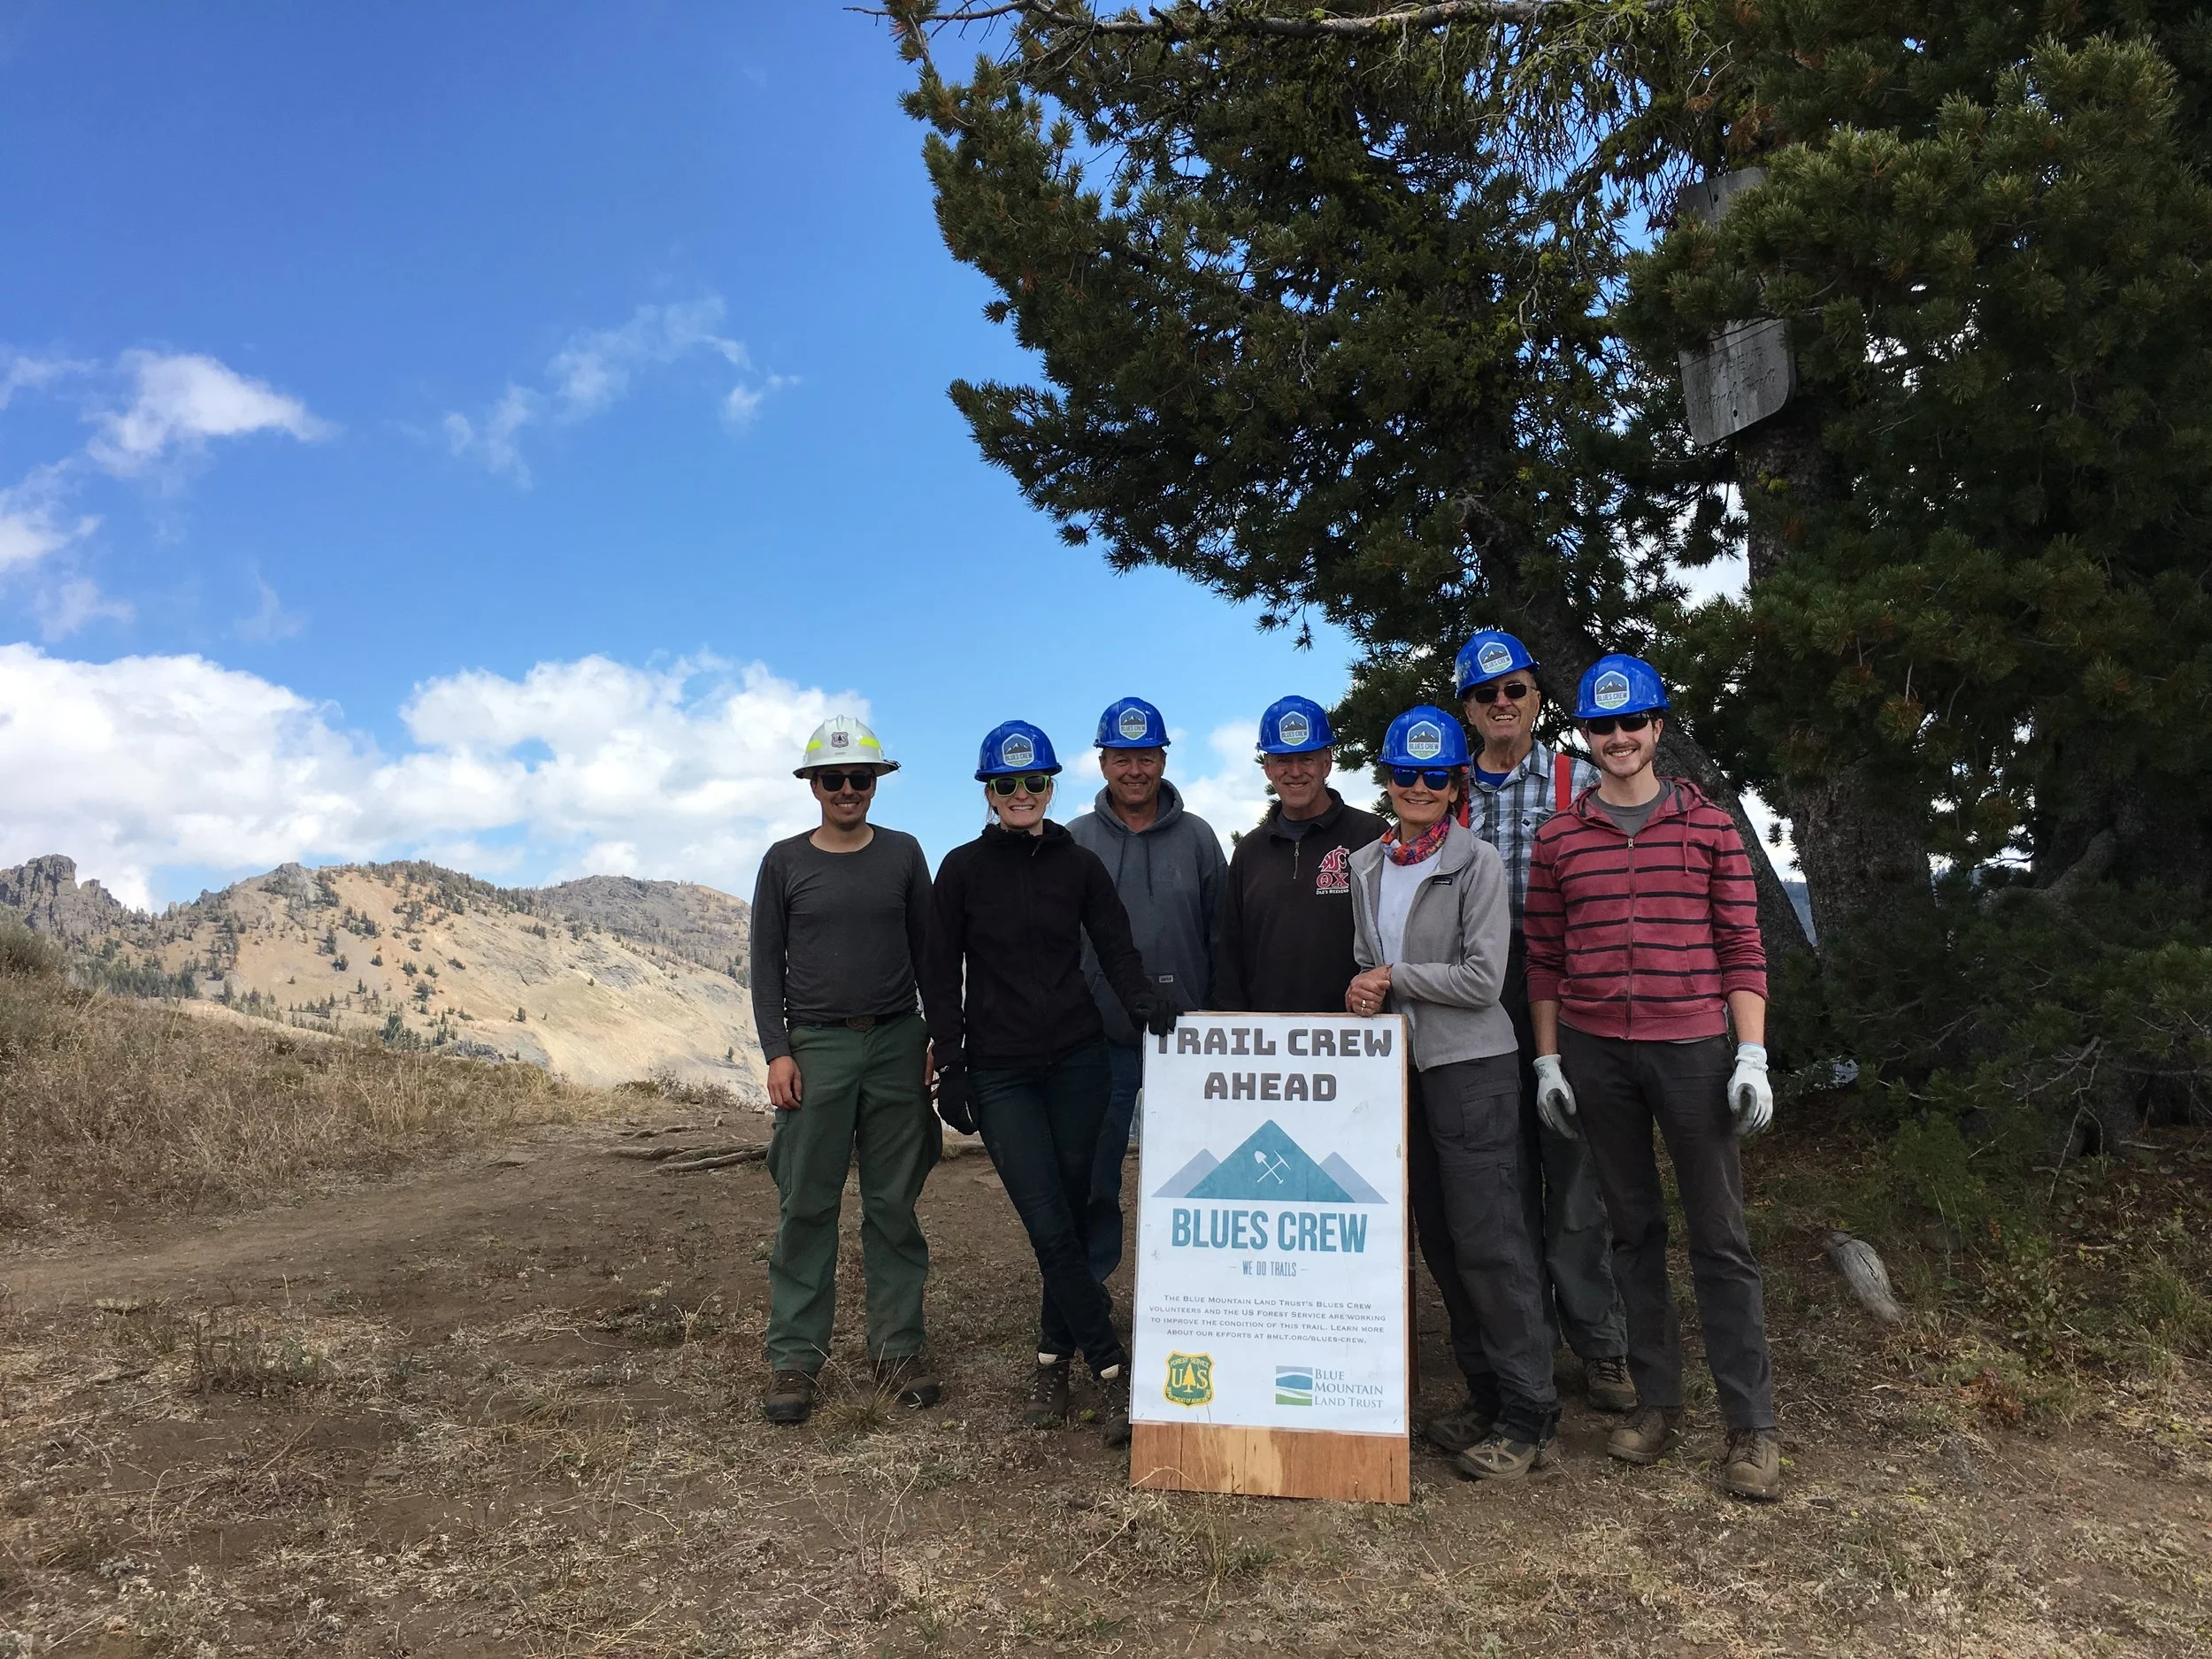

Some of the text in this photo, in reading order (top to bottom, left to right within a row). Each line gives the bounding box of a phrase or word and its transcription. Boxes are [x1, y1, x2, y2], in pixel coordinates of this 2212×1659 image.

[1157, 1026, 1392, 1057] TRAIL CREW
[1204, 1071, 1337, 1102] AHEAD
[1171, 1208, 1368, 1253] BLUES CREW
[1242, 1260, 1297, 1277] WE DO TRAILS
[1208, 1296, 1252, 1305] MOUNTAIN
[1149, 1305, 1202, 1314] VOLUNTEERS
[1219, 1319, 1263, 1328] CONDITION
[1170, 1357, 1189, 1367] FOREST
[1315, 1368, 1346, 1380] BLUE
[1314, 1382, 1384, 1395] MOUNTAIN
[1314, 1395, 1384, 1409] LAND TRUST
